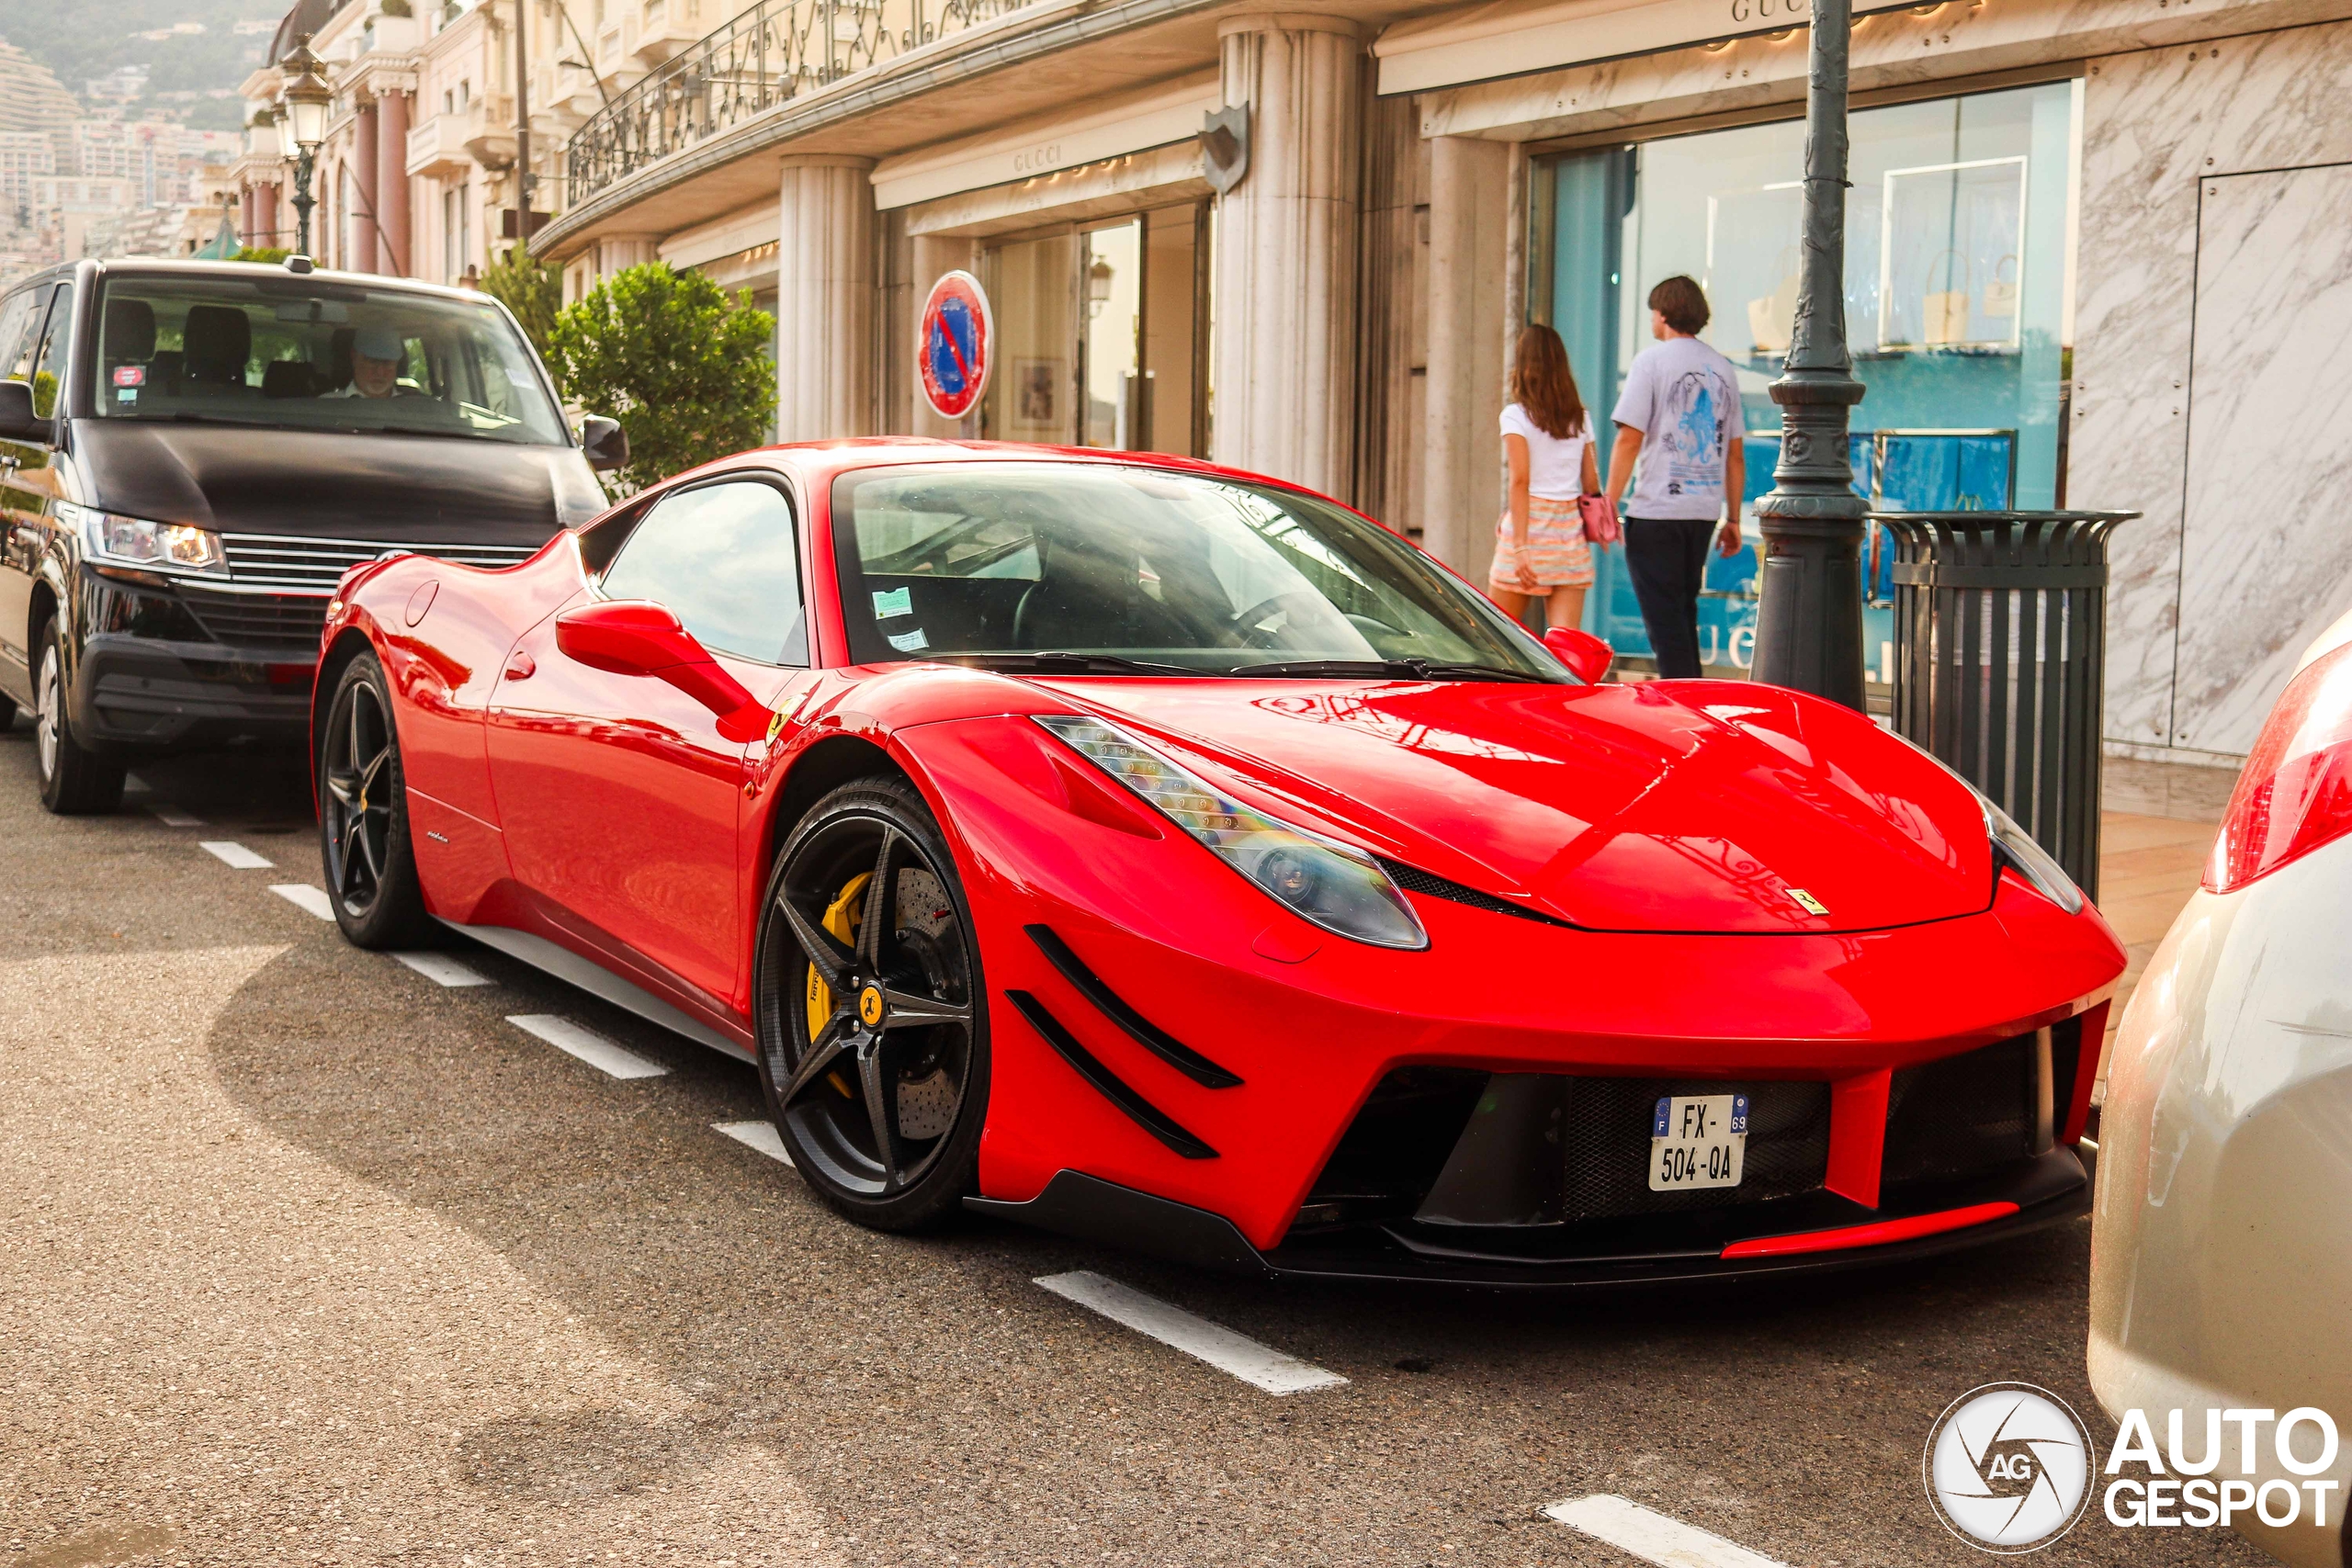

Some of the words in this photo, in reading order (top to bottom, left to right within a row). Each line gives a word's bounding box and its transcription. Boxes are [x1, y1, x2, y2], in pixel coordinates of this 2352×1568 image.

[1732, 0, 1804, 22] GUC
[1013, 144, 1061, 172] GUCCI
[1658, 1121, 1665, 1131] F
[1682, 1104, 1716, 1139] FX-
[1732, 1116, 1746, 1130] 69
[1661, 1145, 1730, 1182] 504-QA
